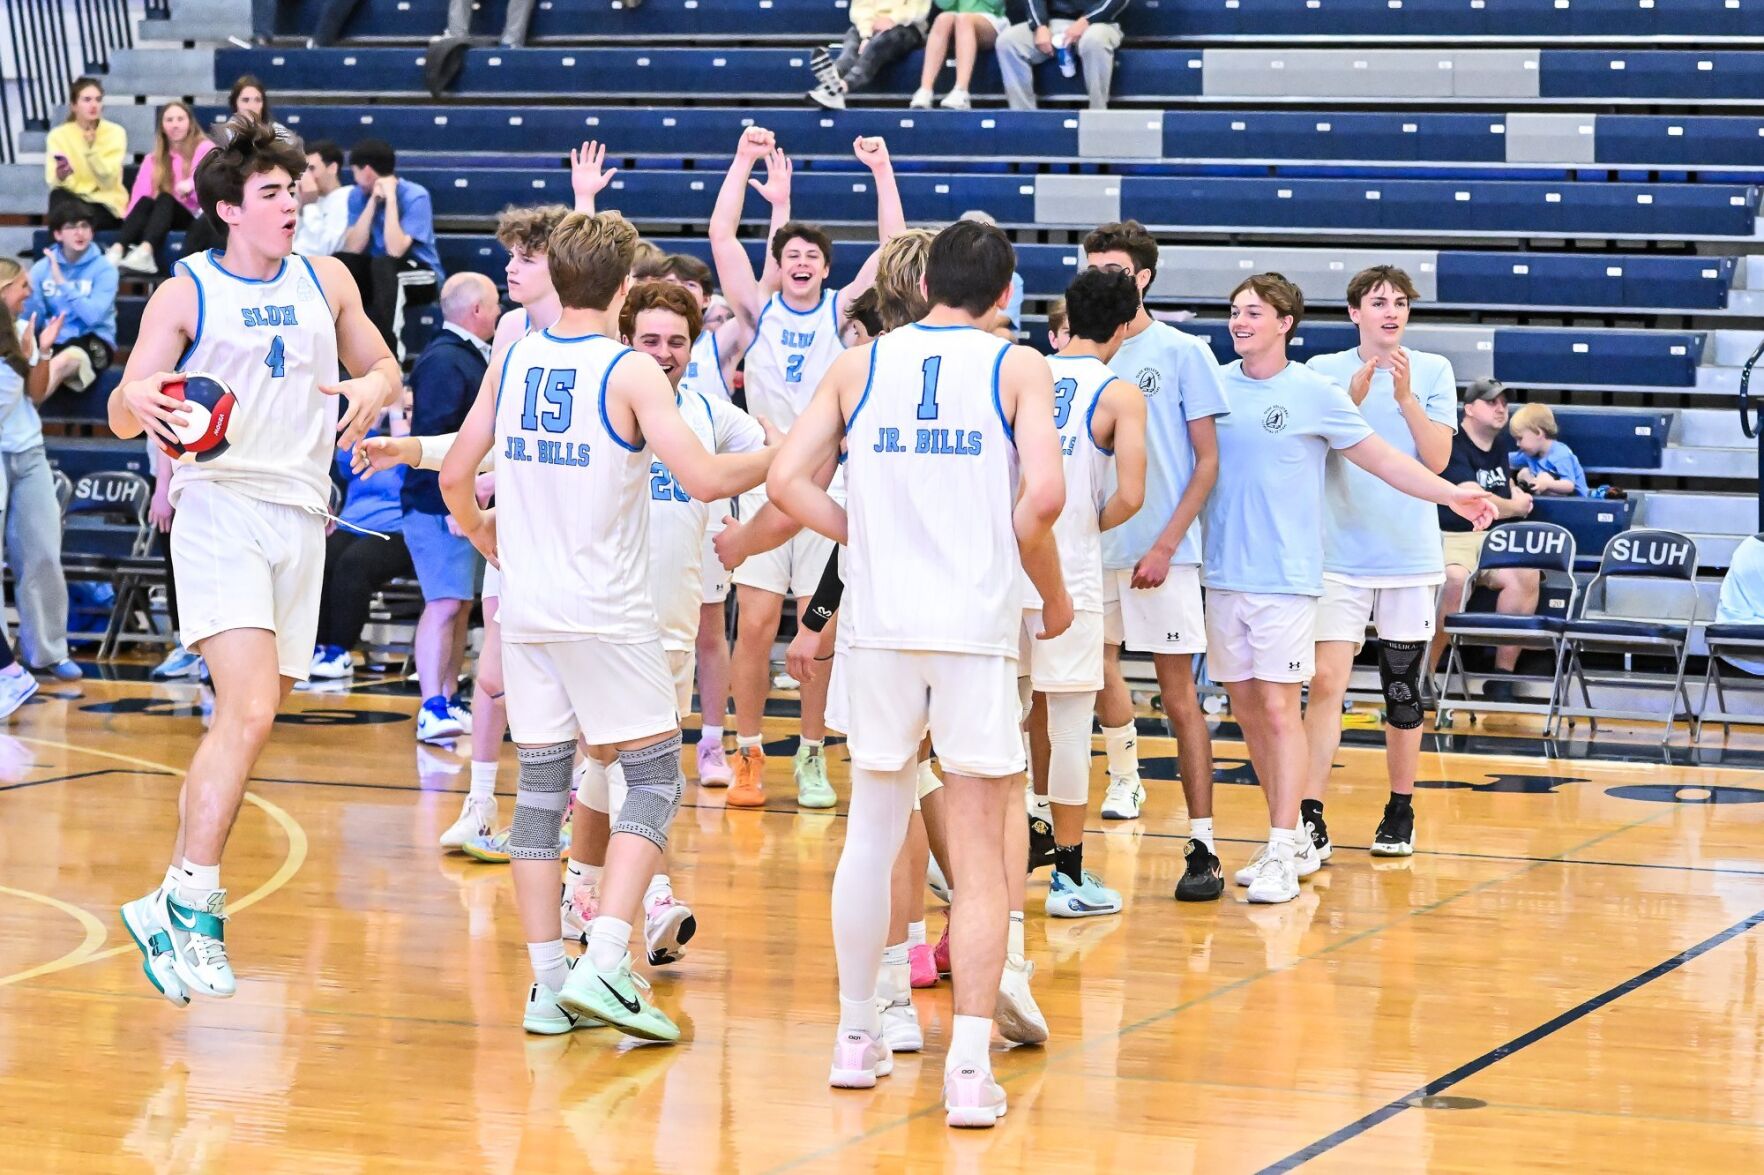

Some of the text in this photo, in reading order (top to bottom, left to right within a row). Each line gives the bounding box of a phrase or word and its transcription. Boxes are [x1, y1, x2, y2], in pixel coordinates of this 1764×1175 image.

[264, 335, 285, 378] 4
[786, 354, 804, 383] 2
[521, 366, 577, 433] 15
[917, 355, 942, 420] 1
[504, 435, 591, 468] JR. BILLS
[873, 427, 983, 456] JR. BILLS
[75, 478, 139, 502] SLUH
[1488, 529, 1567, 554] SLUH
[1611, 538, 1689, 566] SLUH
